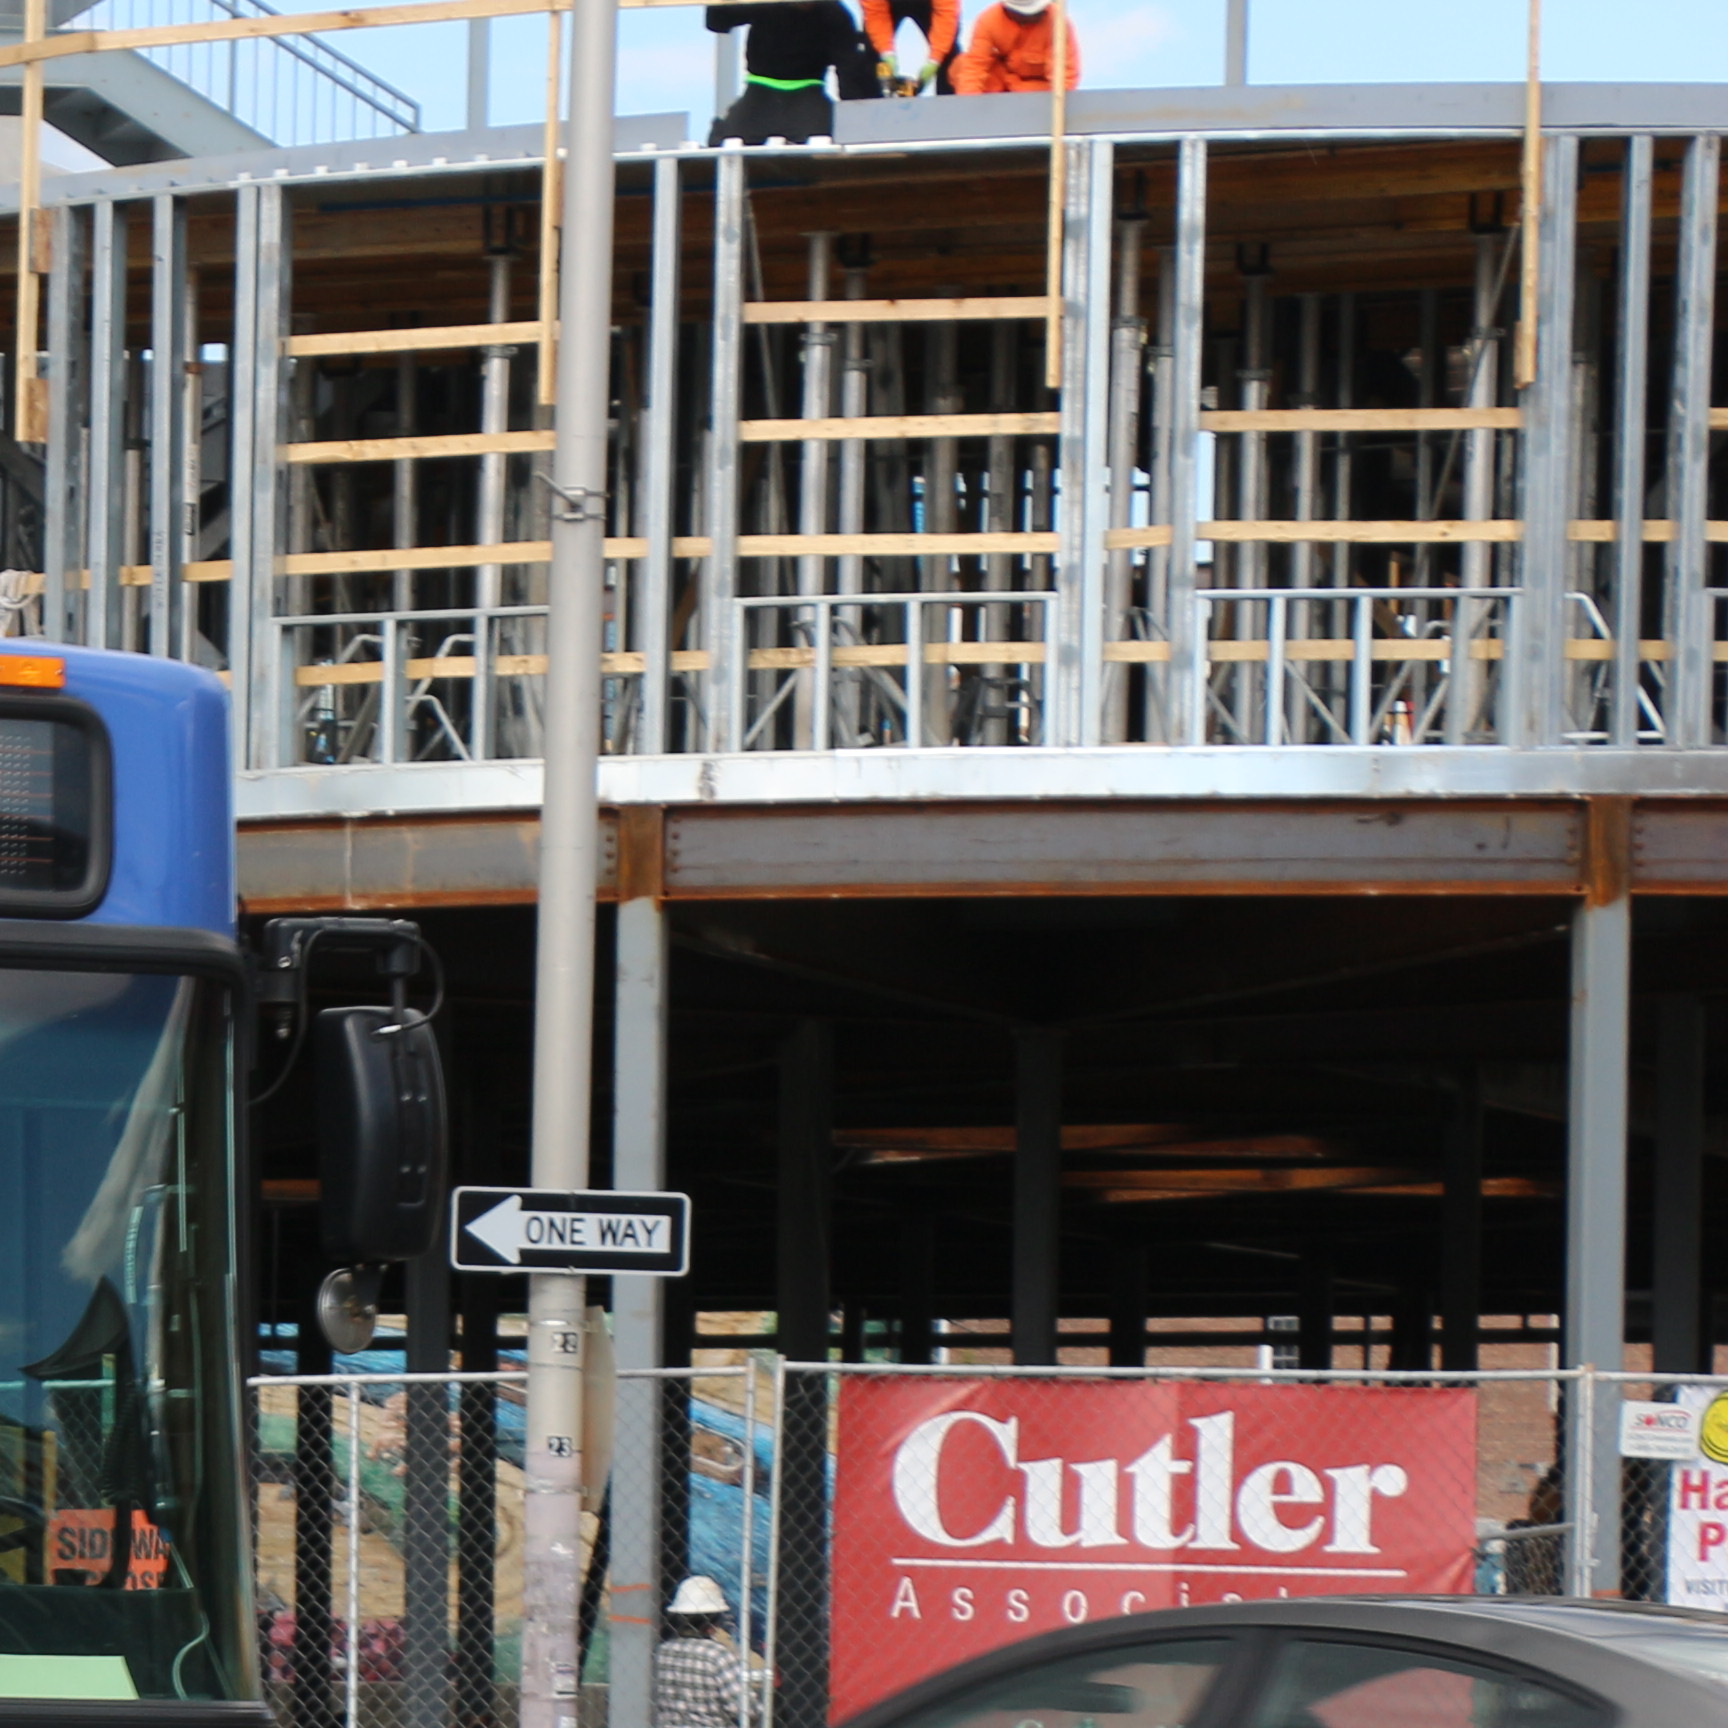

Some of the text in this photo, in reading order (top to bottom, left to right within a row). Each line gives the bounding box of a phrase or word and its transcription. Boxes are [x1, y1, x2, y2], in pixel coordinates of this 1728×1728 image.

[525, 1216, 662, 1247] ONE WAY
[893, 1410, 1408, 1554] Cutler
